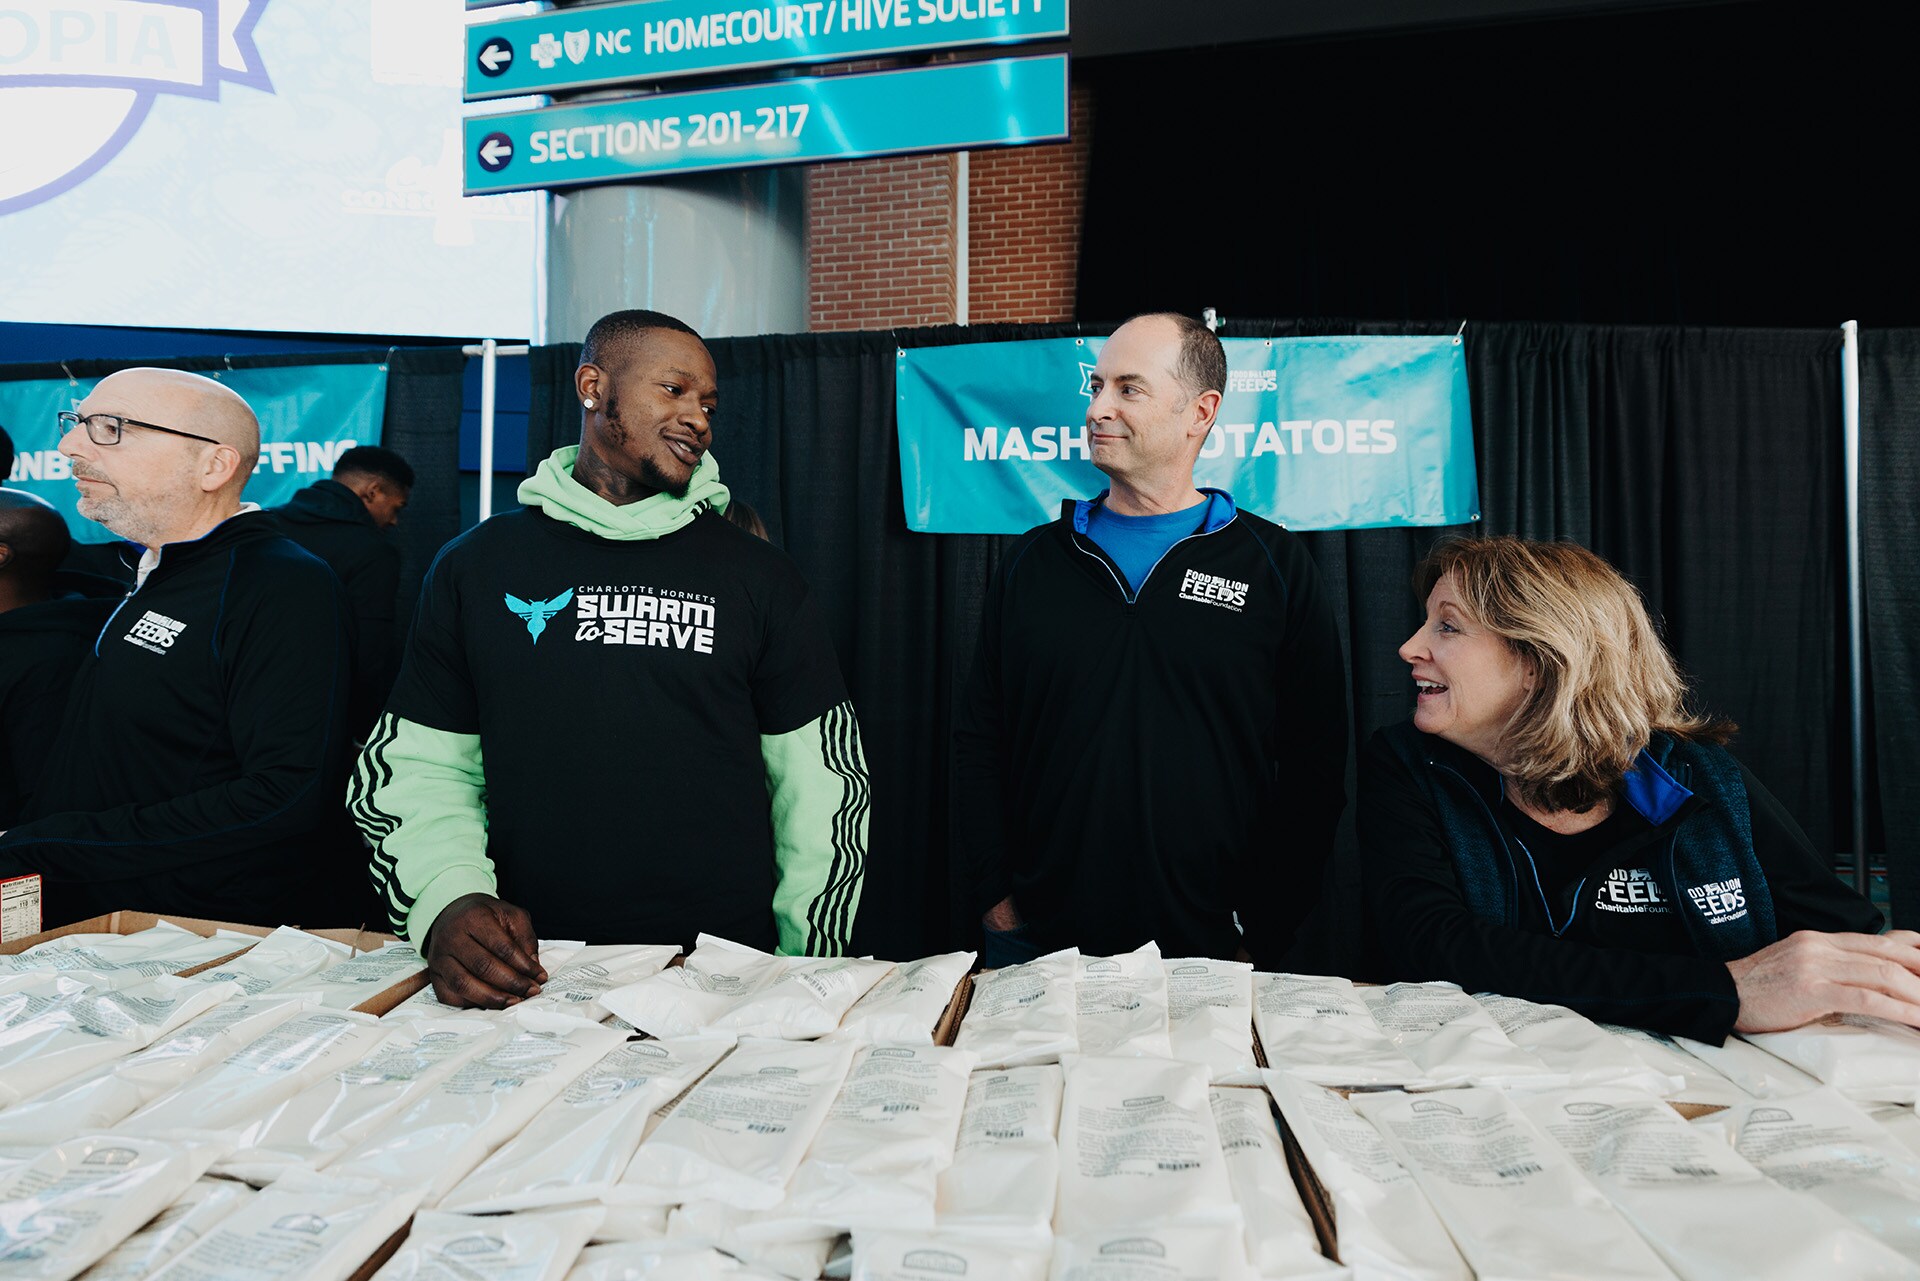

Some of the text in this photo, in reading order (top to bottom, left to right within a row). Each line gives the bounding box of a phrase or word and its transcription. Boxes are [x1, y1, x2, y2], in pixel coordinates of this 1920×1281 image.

[595, 28, 632, 56] NC
[529, 104, 810, 164] SECTIONS 201-217
[1229, 378, 1278, 393] FEEDS
[963, 426, 1091, 461] MASH
[578, 585, 716, 604] CHARLOTTE HORNETS
[1180, 577, 1247, 607] FEEDS
[1185, 568, 1249, 593] FOOD LION
[576, 594, 716, 629] SWARM
[129, 618, 180, 648] FEEDS
[574, 619, 715, 655] to SERVE
[1720, 877, 1742, 893] LION
